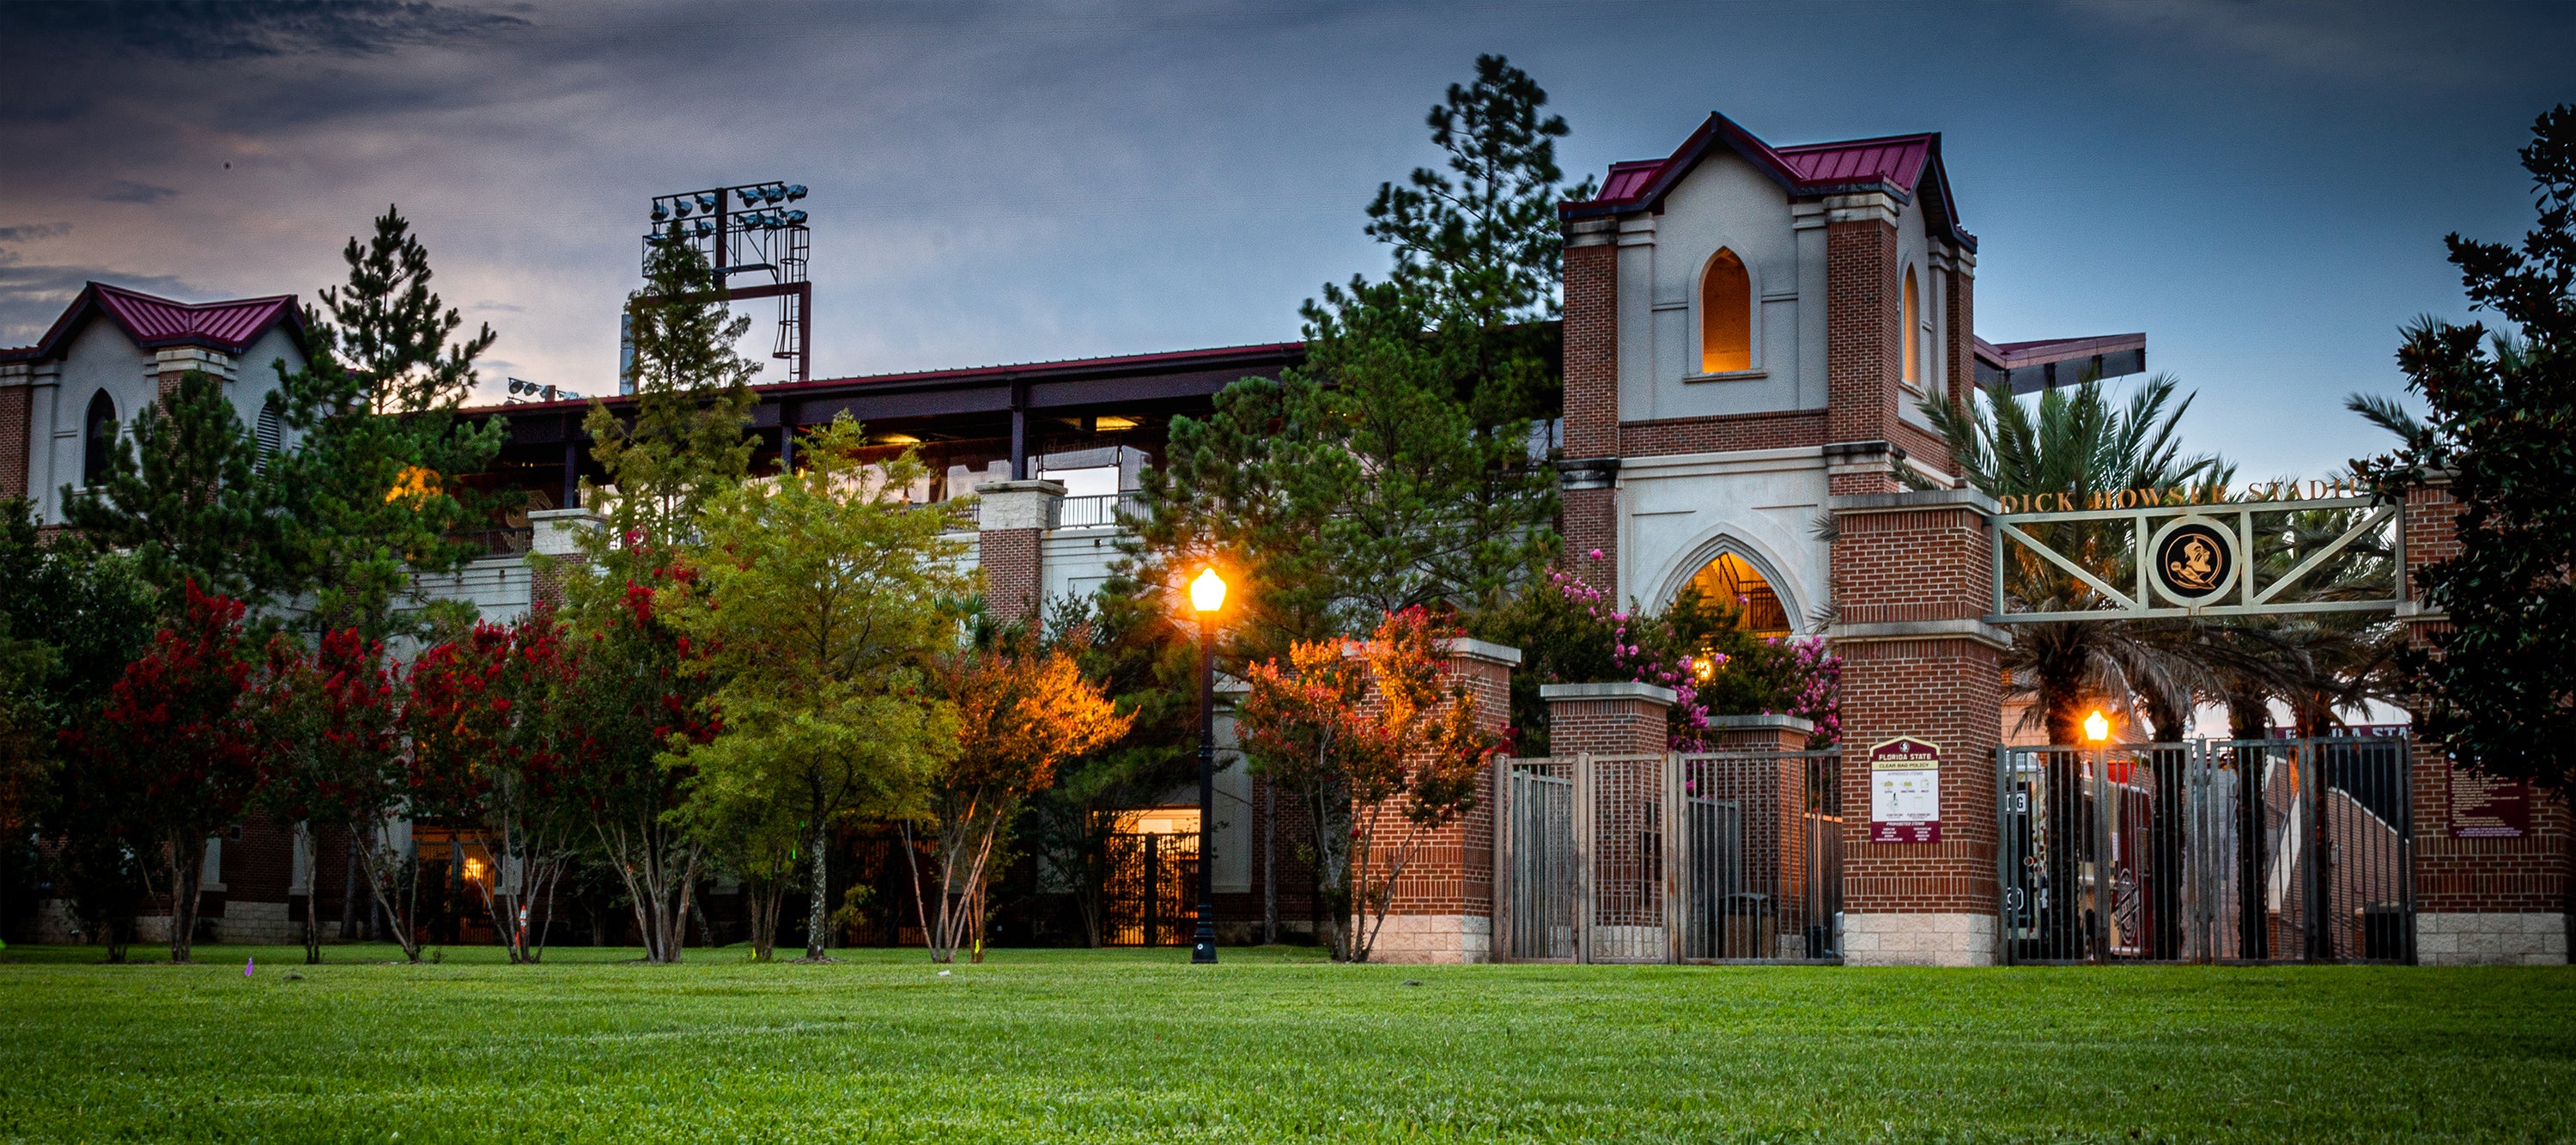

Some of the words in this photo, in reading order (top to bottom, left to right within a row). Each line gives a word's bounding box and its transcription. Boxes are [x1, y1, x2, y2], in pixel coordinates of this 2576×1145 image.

[2000, 492, 2075, 515] DICK
[2093, 484, 2229, 510] HOWSER
[2248, 477, 2370, 502] STADIU
